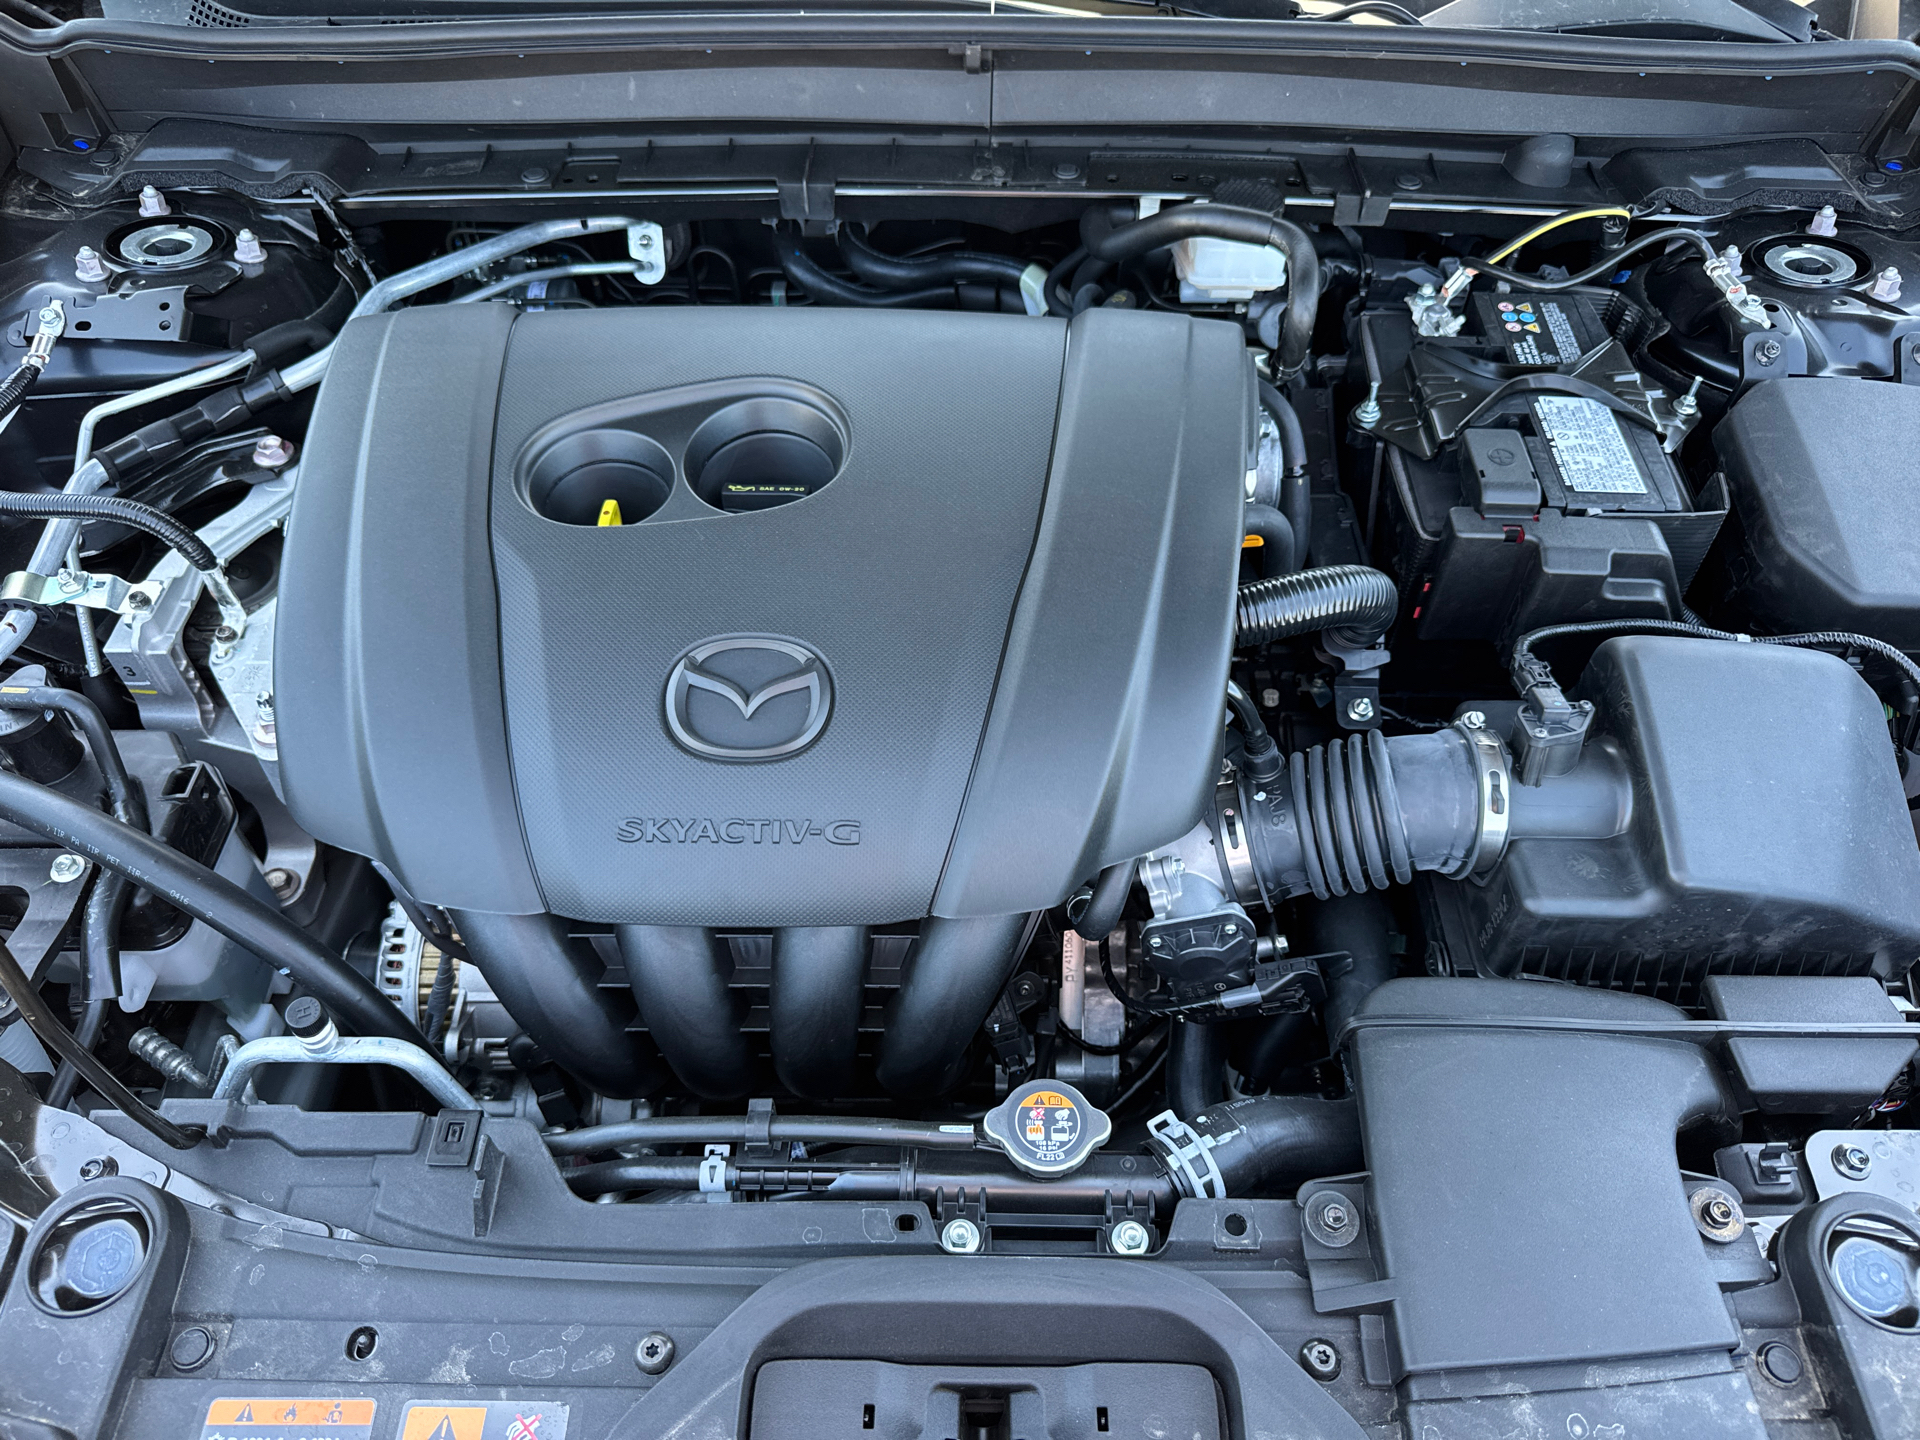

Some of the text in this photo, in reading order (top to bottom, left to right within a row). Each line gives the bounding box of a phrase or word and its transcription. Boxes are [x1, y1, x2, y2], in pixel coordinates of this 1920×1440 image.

[123, 666, 137, 677] 3
[1266, 784, 1287, 828] PAJ8
[616, 816, 862, 847] SKYACTIV-G
[70, 836, 80, 846] PA
[105, 853, 121, 867] PET
[169, 889, 190, 906] 0416
[1036, 1152, 1055, 1161] FL22
